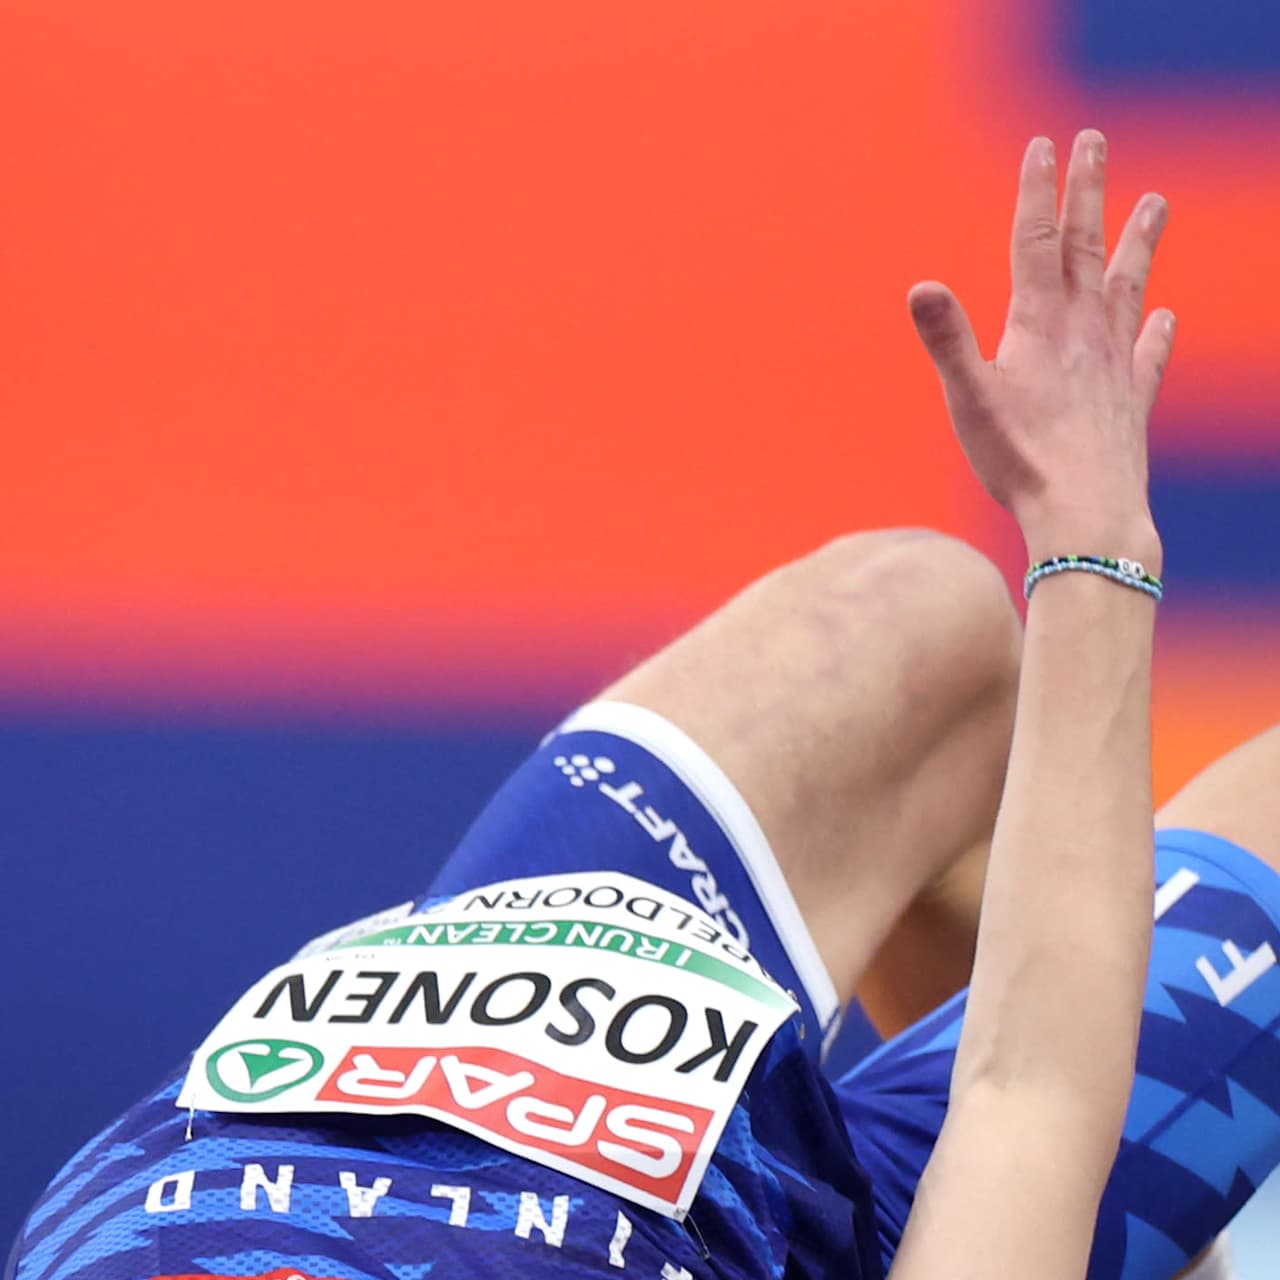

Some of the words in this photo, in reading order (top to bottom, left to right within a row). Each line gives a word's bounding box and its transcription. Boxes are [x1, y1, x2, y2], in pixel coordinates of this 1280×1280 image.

[599, 781, 751, 950] CRAFT
[464, 885, 770, 977] PELDOORN
[568, 926, 671, 963] RUN
[678, 948, 693, 968] I
[253, 969, 759, 1084] KOSONEN
[335, 1049, 696, 1180] SPAR
